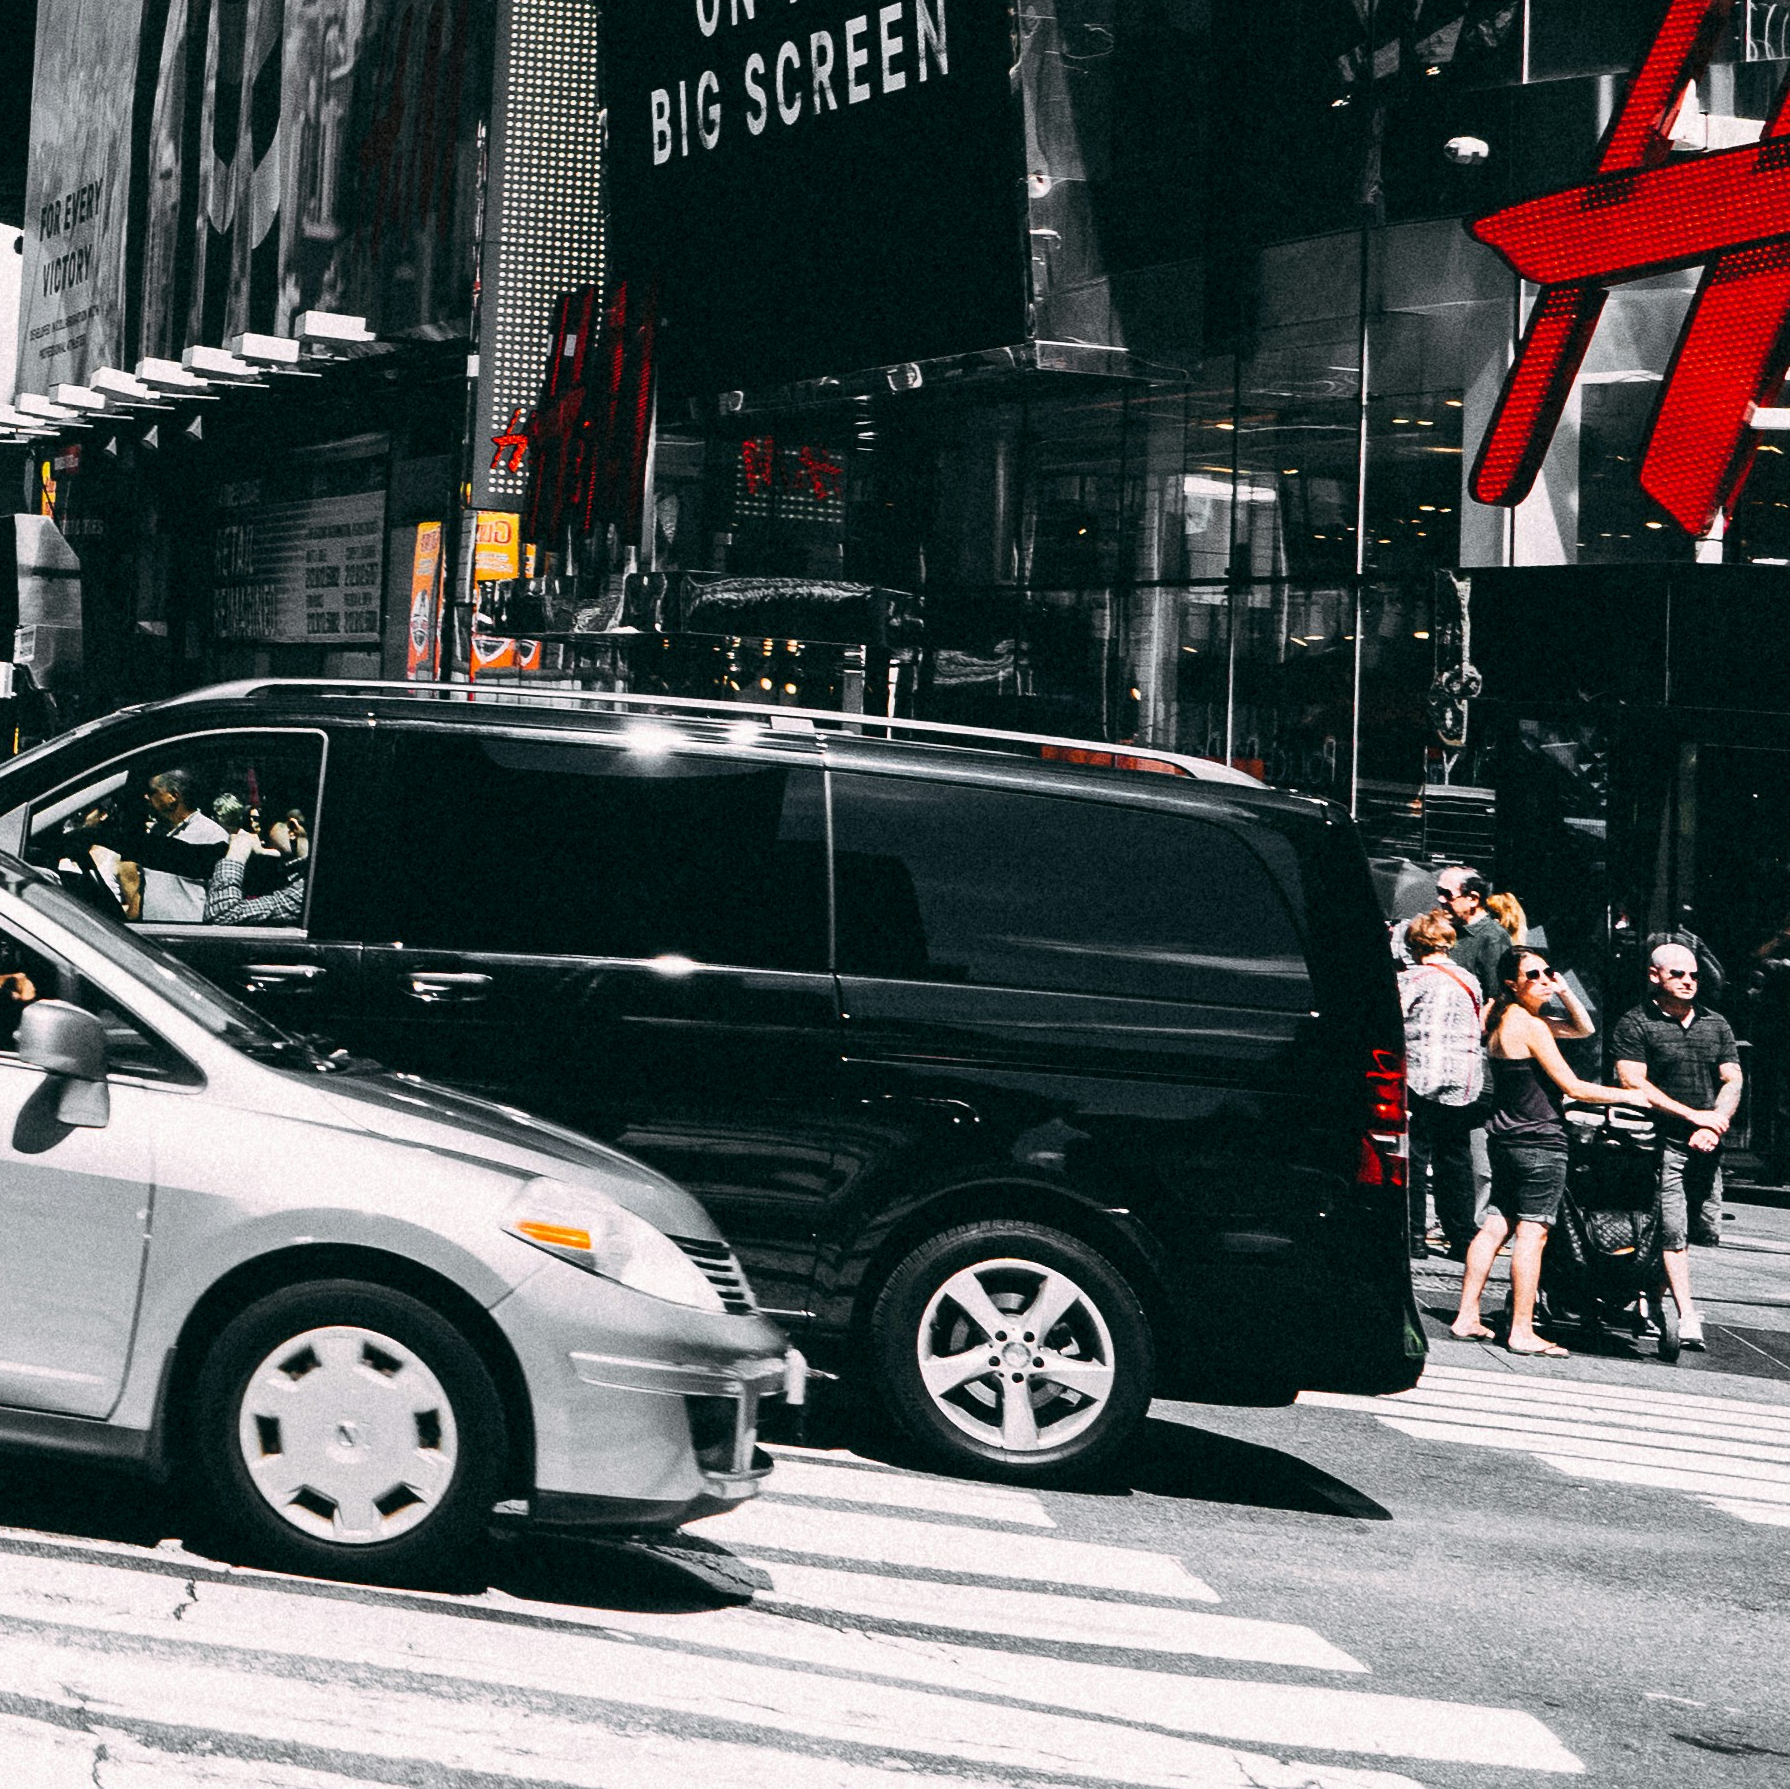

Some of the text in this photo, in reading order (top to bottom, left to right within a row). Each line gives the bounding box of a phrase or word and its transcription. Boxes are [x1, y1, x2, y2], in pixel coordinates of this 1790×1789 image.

[649, 70, 723, 168] BIG
[40, 178, 103, 242] FOR EVERY
[43, 244, 93, 297] VICTORY
